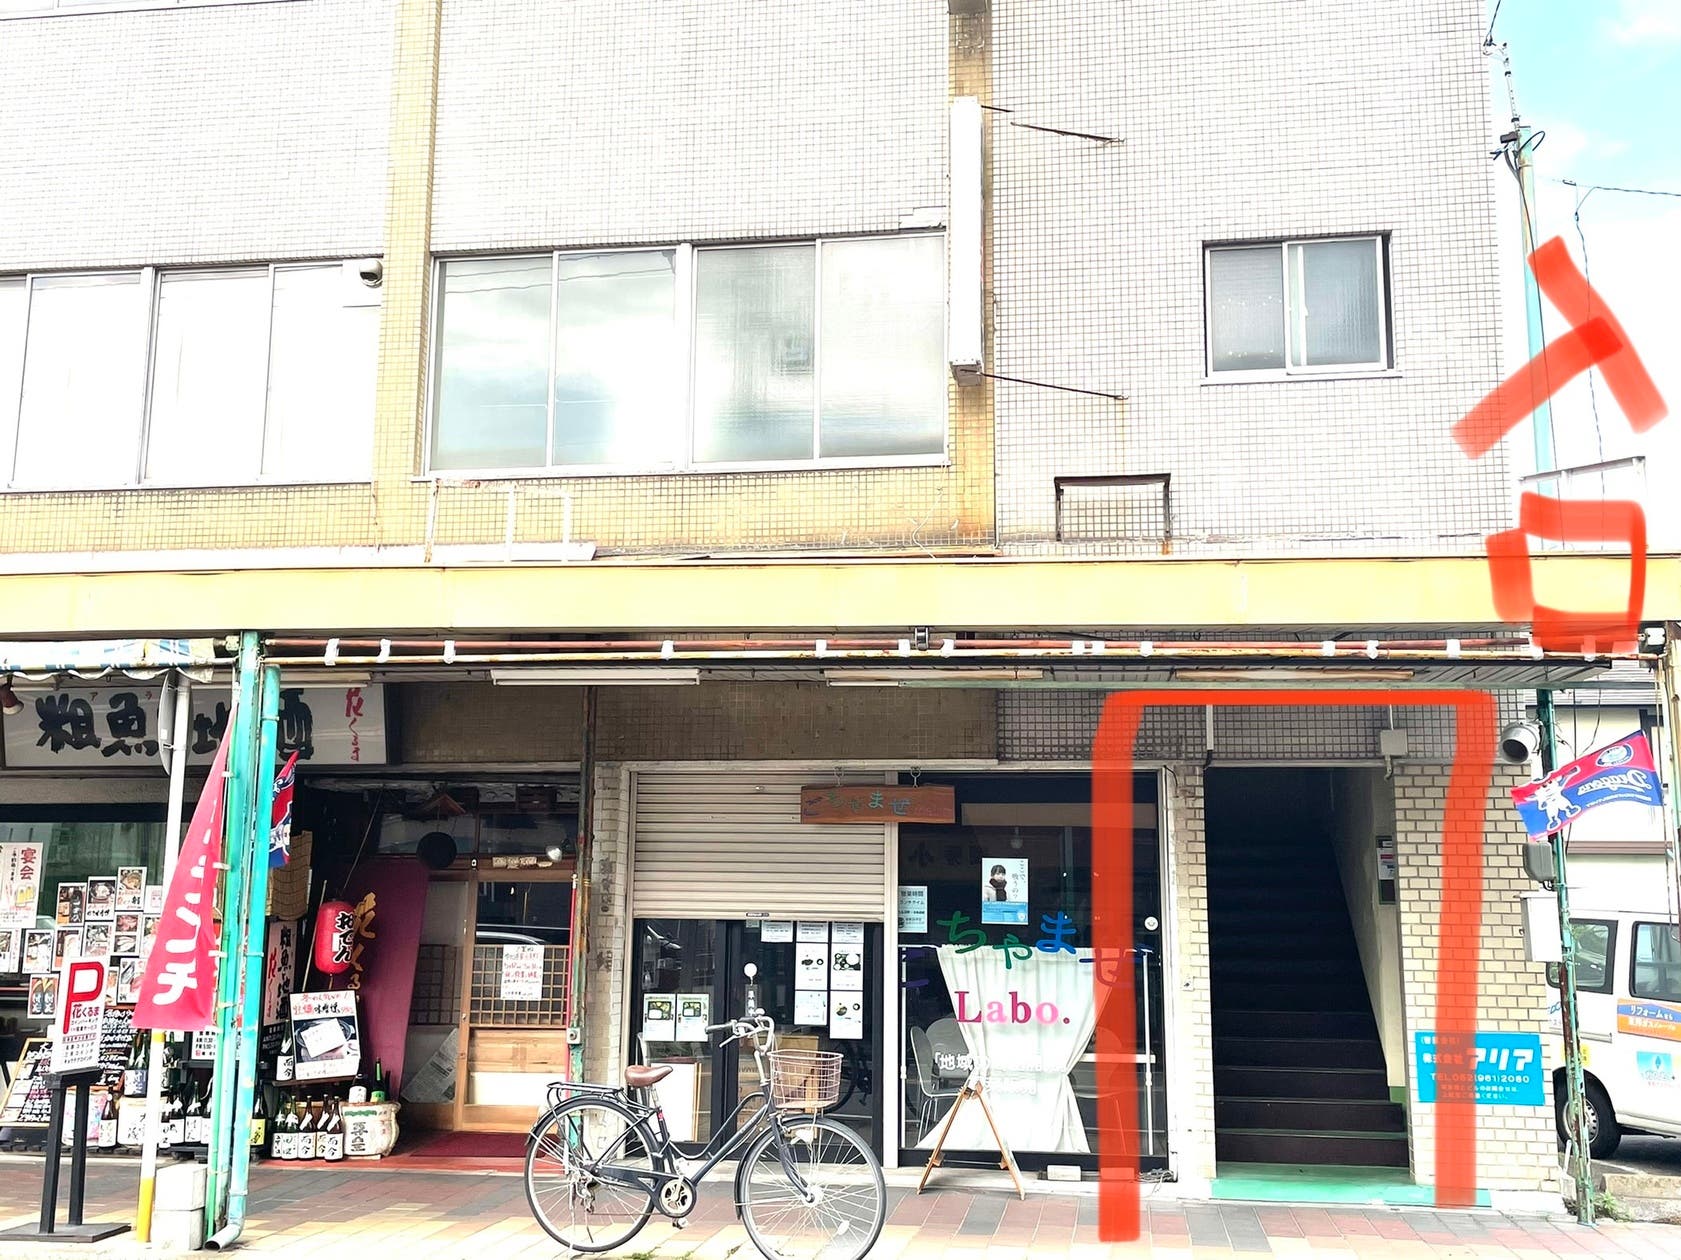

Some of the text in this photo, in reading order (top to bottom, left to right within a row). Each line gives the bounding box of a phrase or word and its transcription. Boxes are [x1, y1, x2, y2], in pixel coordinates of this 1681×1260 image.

[20, 847, 37, 880] 宴会
[334, 911, 354, 963] おでん
[63, 961, 104, 1035] P
[72, 1004, 100, 1019] 花くるま
[954, 990, 1070, 1024] Labo.
[1466, 1047, 1534, 1071] アリア
